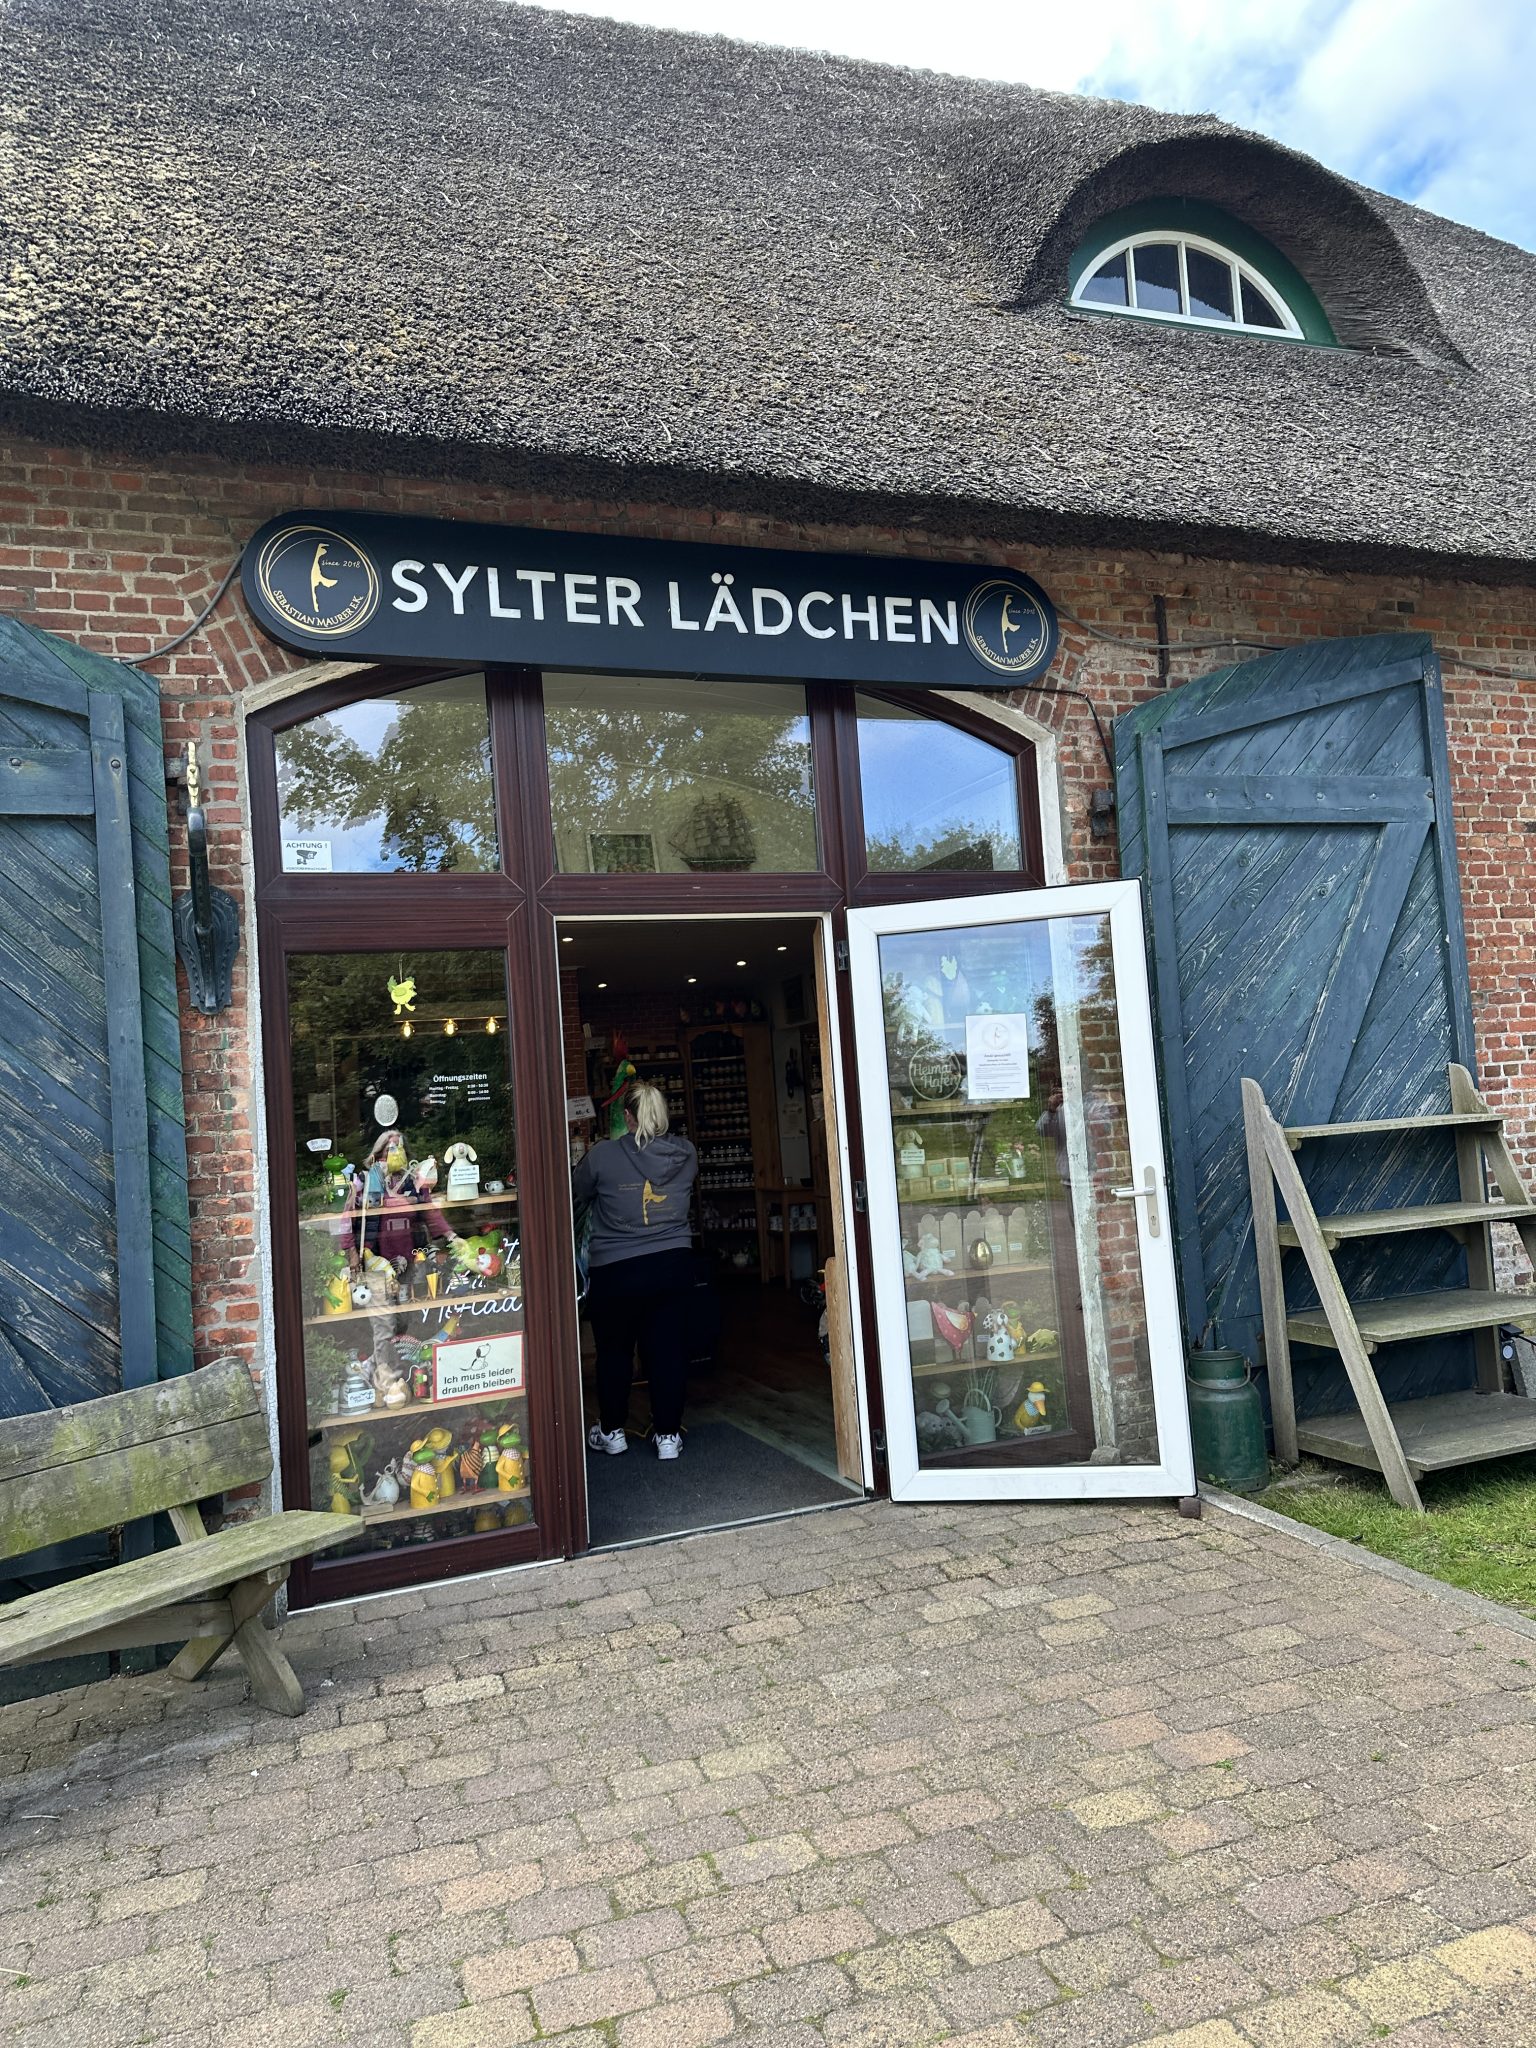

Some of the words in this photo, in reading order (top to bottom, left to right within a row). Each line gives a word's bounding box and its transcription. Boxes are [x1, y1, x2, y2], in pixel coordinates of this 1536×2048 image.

[342, 560, 361, 569] 2018
[273, 590, 315, 625] SEBASTIAN
[316, 607, 353, 627] MAURER
[391, 559, 645, 628] SYLTER
[668, 572, 959, 645] LÄDCHEN
[976, 635, 1006, 664] SEBASTIAN
[1006, 650, 1032, 665] MAURER
[433, 1073, 487, 1082] Öffnungszeiten
[444, 1376, 459, 1384] Ich
[461, 1372, 486, 1381] muss
[488, 1367, 514, 1377] leider
[442, 1384, 480, 1395] draußen
[482, 1377, 516, 1388] bleiben
